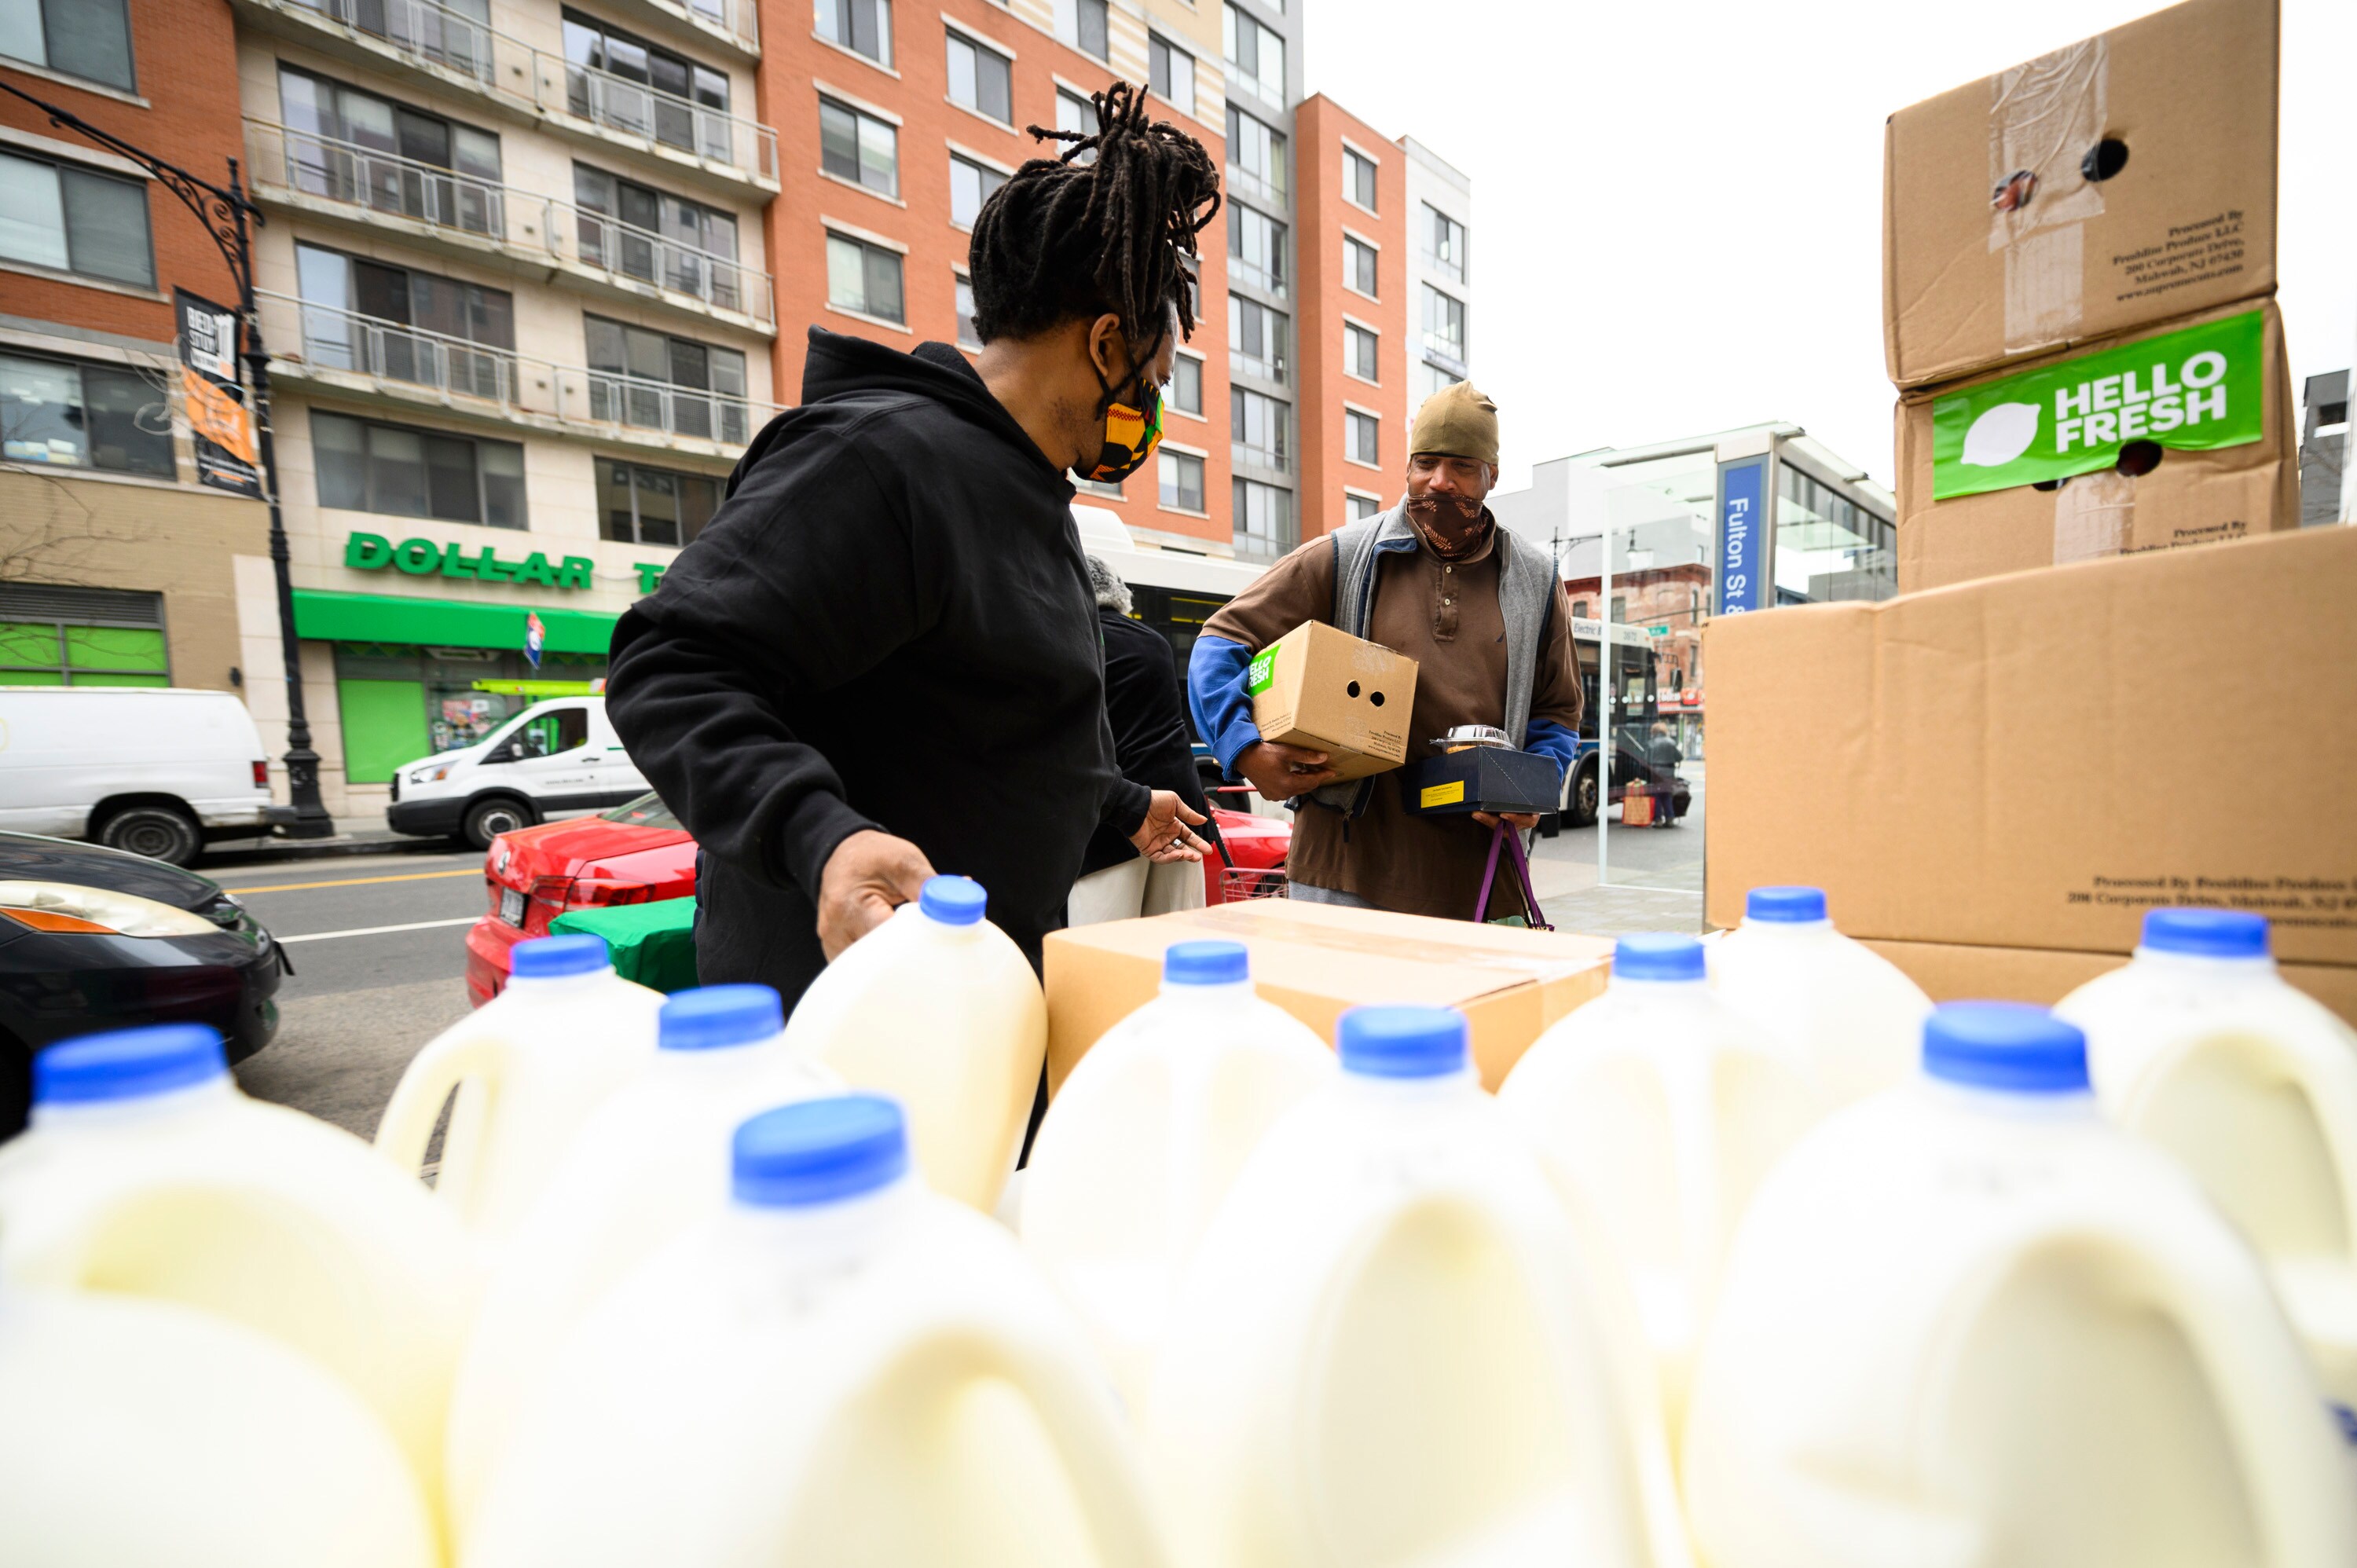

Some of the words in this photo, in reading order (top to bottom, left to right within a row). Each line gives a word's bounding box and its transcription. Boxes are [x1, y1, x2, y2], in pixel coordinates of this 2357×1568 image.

[2165, 233, 2212, 251] Produce
[2215, 221, 2245, 237] LLC
[2168, 213, 2224, 237] Processed
[2227, 210, 2244, 221] By
[2146, 247, 2205, 269] Corporate
[2190, 258, 2206, 272] NJ
[2055, 350, 2227, 422] HELLO
[2055, 383, 2227, 454] FRESH
[1727, 497, 1749, 569] Fulton
[344, 531, 594, 590] DOLLAR
[633, 562, 666, 595] T
[1725, 573, 1747, 600] St
[1574, 622, 1595, 636] Electric
[1248, 666, 1269, 689] RESH
[1249, 655, 1272, 676] ELLO
